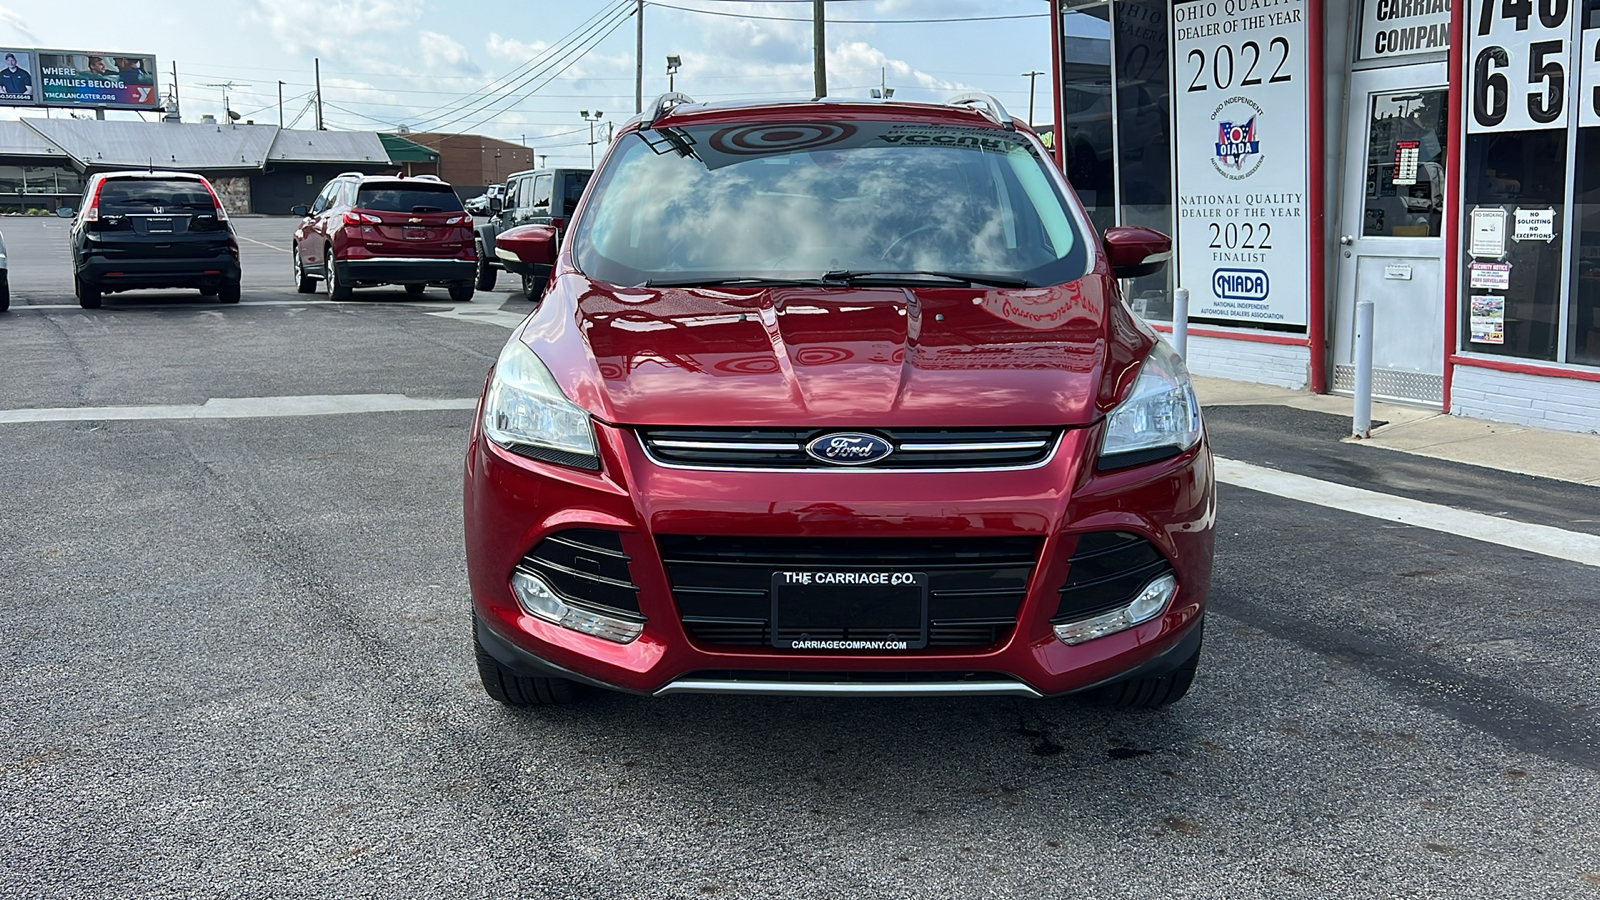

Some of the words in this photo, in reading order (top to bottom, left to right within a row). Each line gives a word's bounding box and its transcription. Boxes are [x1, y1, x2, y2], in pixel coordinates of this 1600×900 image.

[1175, 3, 1217, 22] OHIO
[1178, 23, 1220, 41] DEALER
[1223, 20, 1238, 34] OF
[1241, 15, 1265, 31] THE
[1268, 9, 1301, 27] YEAR
[1187, 36, 1292, 92] 2022
[42, 66, 76, 76] WHERE
[43, 78, 86, 88] FAMILIES
[88, 79, 127, 89] BELONG.
[44, 92, 116, 101] YMCALANCASTER.ORG
[1210, 104, 1224, 121] OHIO
[1223, 96, 1264, 116] INDEPENDENT
[1220, 143, 1252, 156] OIADA
[1181, 195, 1241, 206] NATIONAL
[1246, 193, 1302, 206] QUALITY
[1182, 208, 1221, 218] DEALER
[1226, 208, 1240, 218] OF
[1244, 208, 1265, 218] THE
[1271, 207, 1301, 218] YEAR
[1208, 222, 1272, 250] 2022
[1213, 252, 1266, 263] FINALIST
[1217, 274, 1264, 297] NIADA
[1213, 301, 1237, 309] NATIONAL
[1237, 302, 1270, 311] INDEPENDENT
[1201, 308, 1230, 316] AUTOMOBILE
[1230, 310, 1250, 318] DEALERS
[1251, 311, 1284, 320] ASSOCIATION
[826, 437, 874, 457] Ford
[783, 572, 812, 584] THE
[815, 572, 889, 584] CARRIAGE
[891, 572, 916, 584] CO.
[791, 640, 907, 650] CARRIAGECOMPANY.COM
